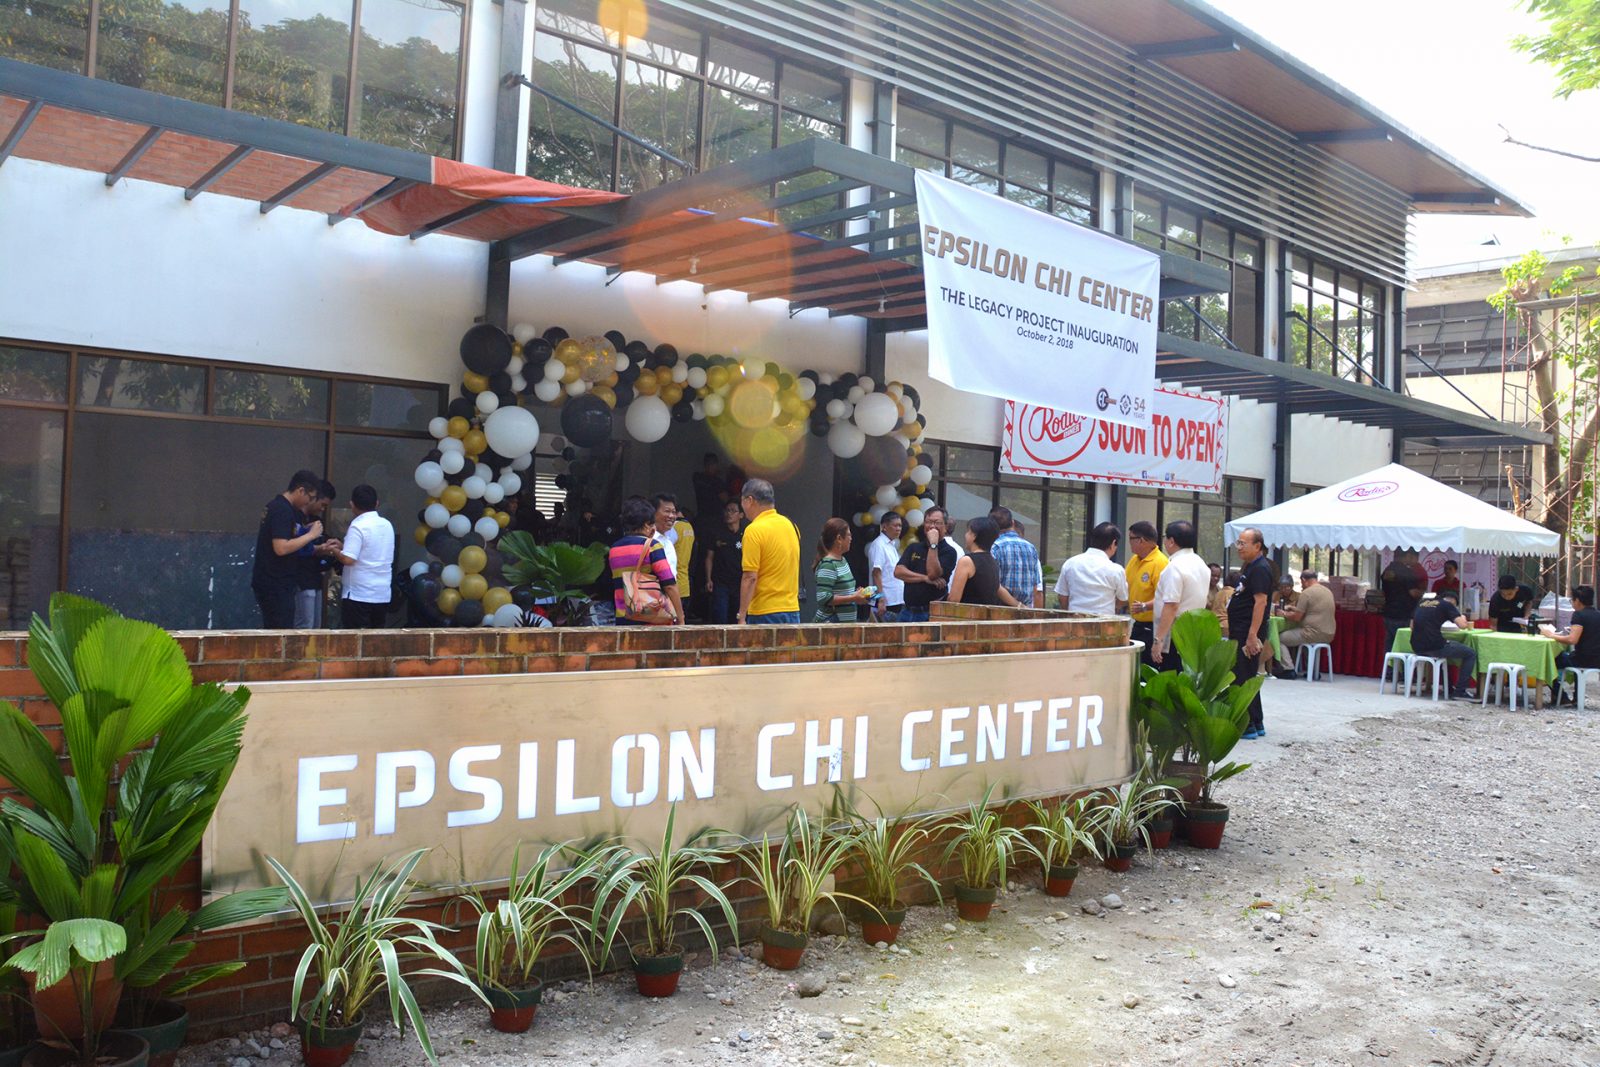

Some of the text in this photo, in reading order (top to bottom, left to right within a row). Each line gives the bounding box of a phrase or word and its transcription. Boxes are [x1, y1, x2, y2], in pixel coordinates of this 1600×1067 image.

[924, 224, 1154, 323] EPSILON CHI CENTER
[940, 286, 1139, 355] THE LEGACY PROJECT INAUGURATION
[1016, 326, 1074, 350] October 2, 2018
[1134, 396, 1146, 412] 54
[1098, 413, 1216, 463] SOON TO OPEN
[296, 694, 1104, 844] EPSILON CHI CENTER
